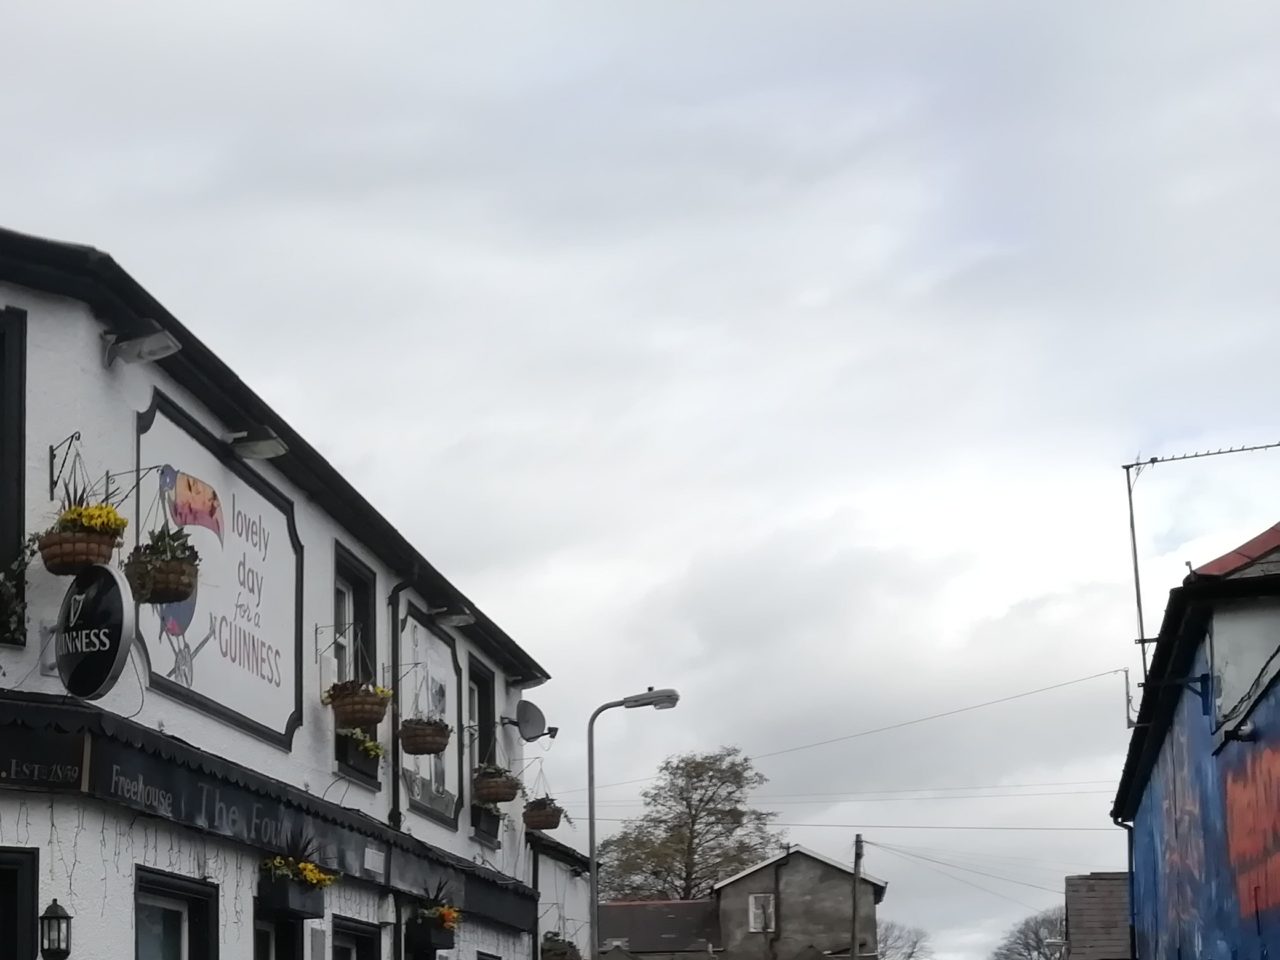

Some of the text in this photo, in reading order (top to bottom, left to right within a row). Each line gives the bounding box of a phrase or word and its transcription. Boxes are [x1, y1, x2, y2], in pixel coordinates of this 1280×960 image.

[231, 494, 270, 562] lovely
[237, 553, 264, 606] day
[233, 591, 261, 629] for a
[218, 615, 282, 688] GUINNESS
[110, 764, 173, 812] Freehouse
[197, 782, 240, 830] The
